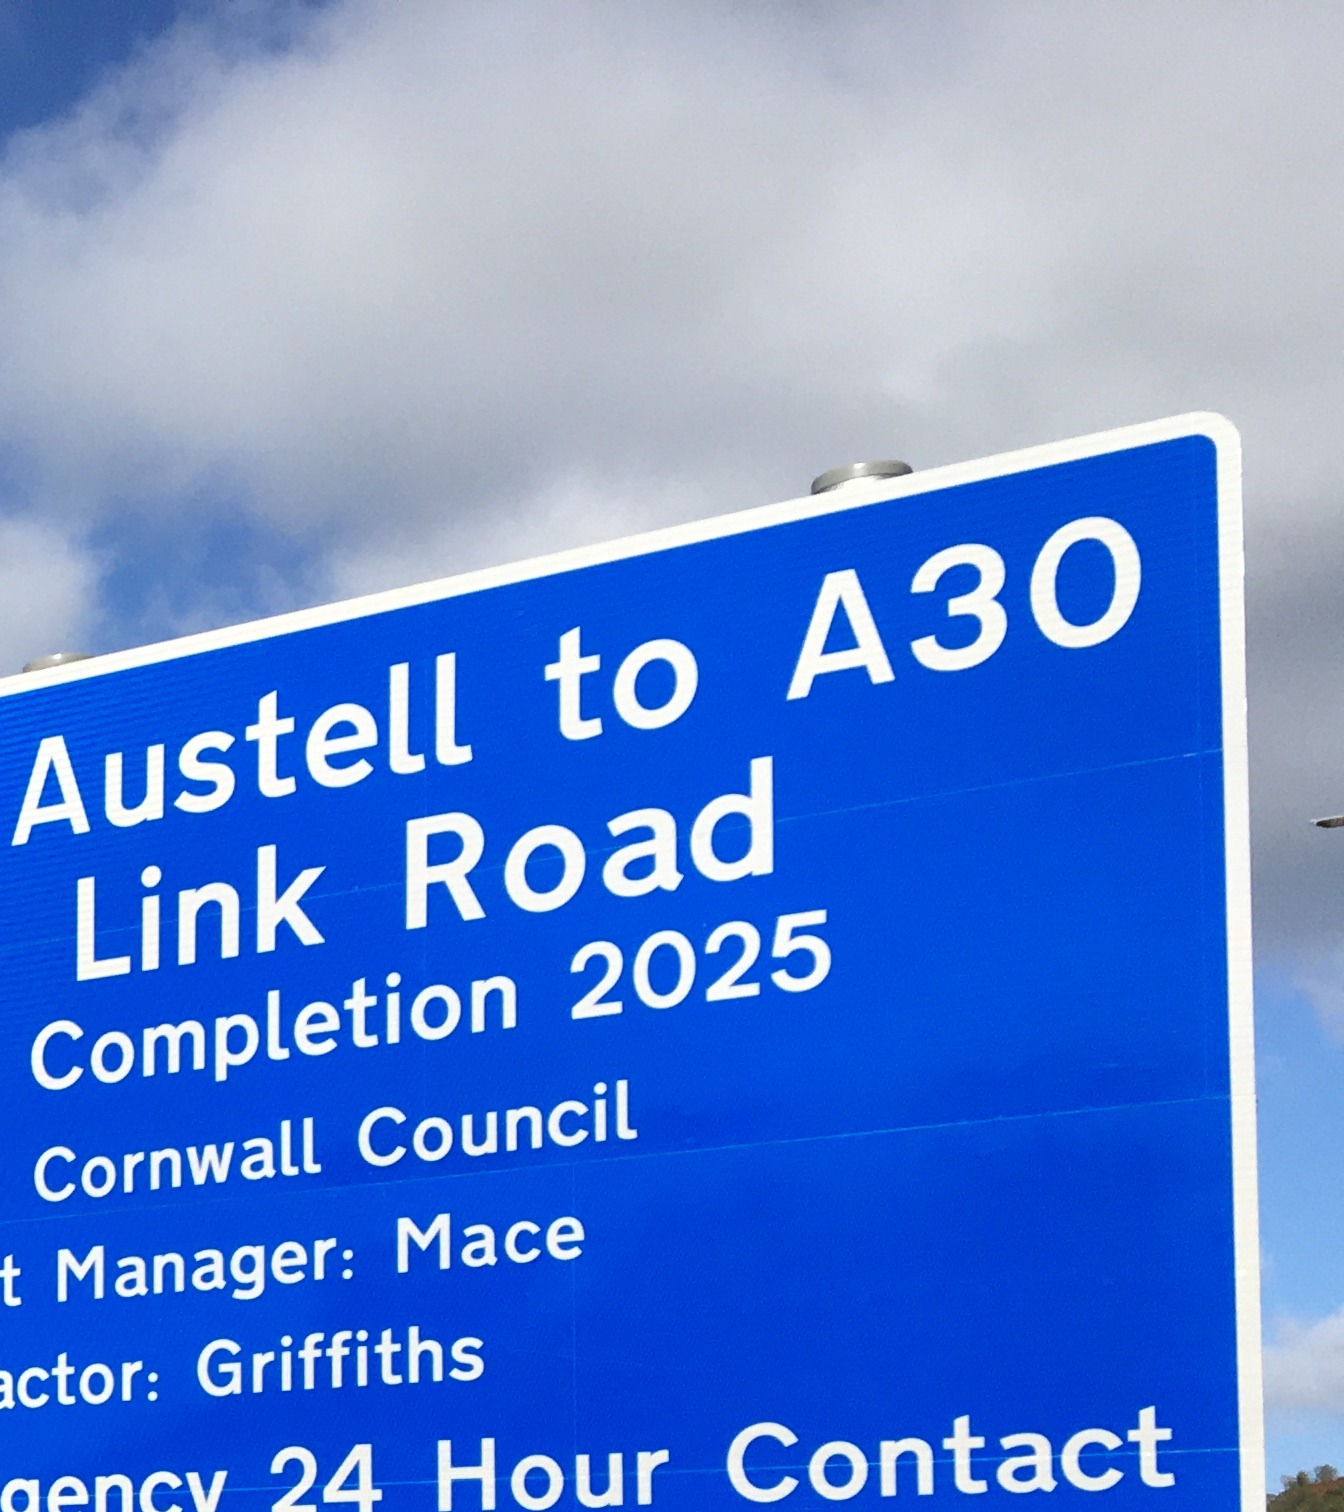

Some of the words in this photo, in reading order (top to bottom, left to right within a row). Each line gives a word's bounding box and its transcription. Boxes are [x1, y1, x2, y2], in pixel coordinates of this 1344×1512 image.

[12, 653, 472, 845] Austell
[545, 627, 698, 740] to
[787, 517, 1141, 700] A30
[77, 845, 325, 981] Link
[406, 756, 773, 929] Road
[31, 973, 516, 1090] Completion
[571, 910, 831, 1019] 2025
[34, 1118, 321, 1201] Cornwall
[359, 1080, 637, 1166] Council
[58, 1238, 353, 1302] Manager:
[398, 1214, 584, 1273] Mace
[198, 1326, 484, 1396] Griffiths
[438, 1438, 669, 1511] Hour
[727, 1406, 1175, 1502] Contact
